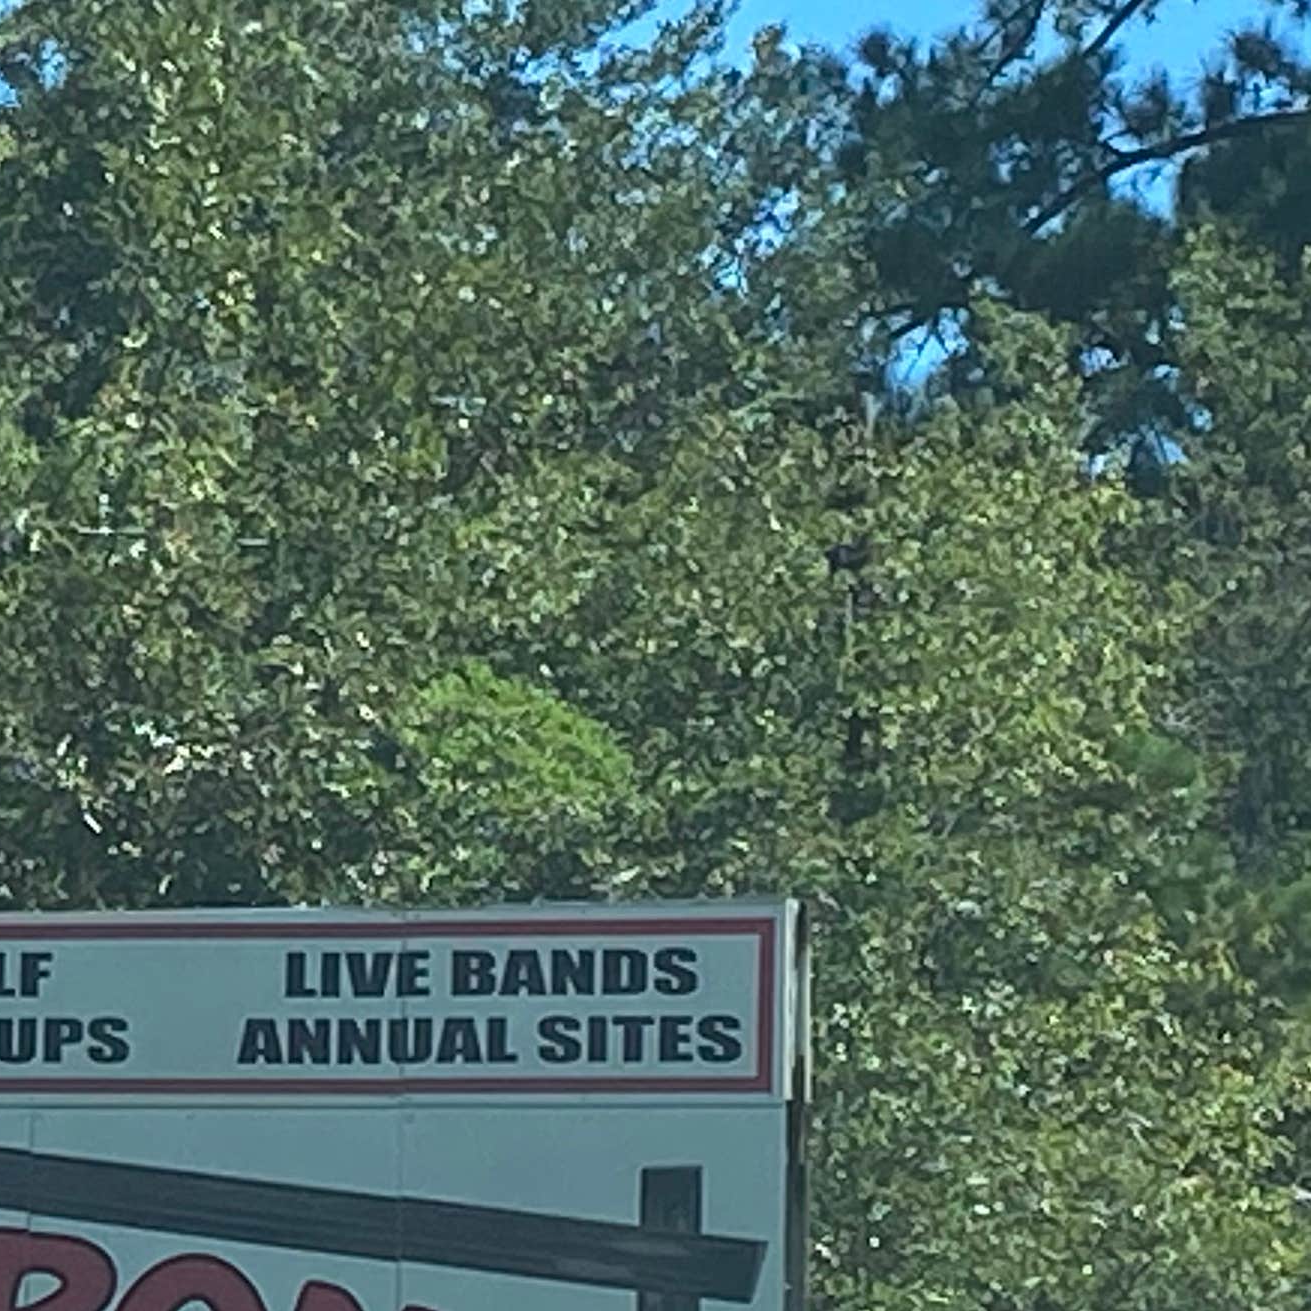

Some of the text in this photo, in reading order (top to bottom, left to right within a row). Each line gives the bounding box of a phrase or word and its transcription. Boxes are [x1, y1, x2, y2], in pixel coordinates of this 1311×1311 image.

[283, 946, 699, 998] LIVE BANDS
[237, 1014, 743, 1065] ANNUAL SITES
